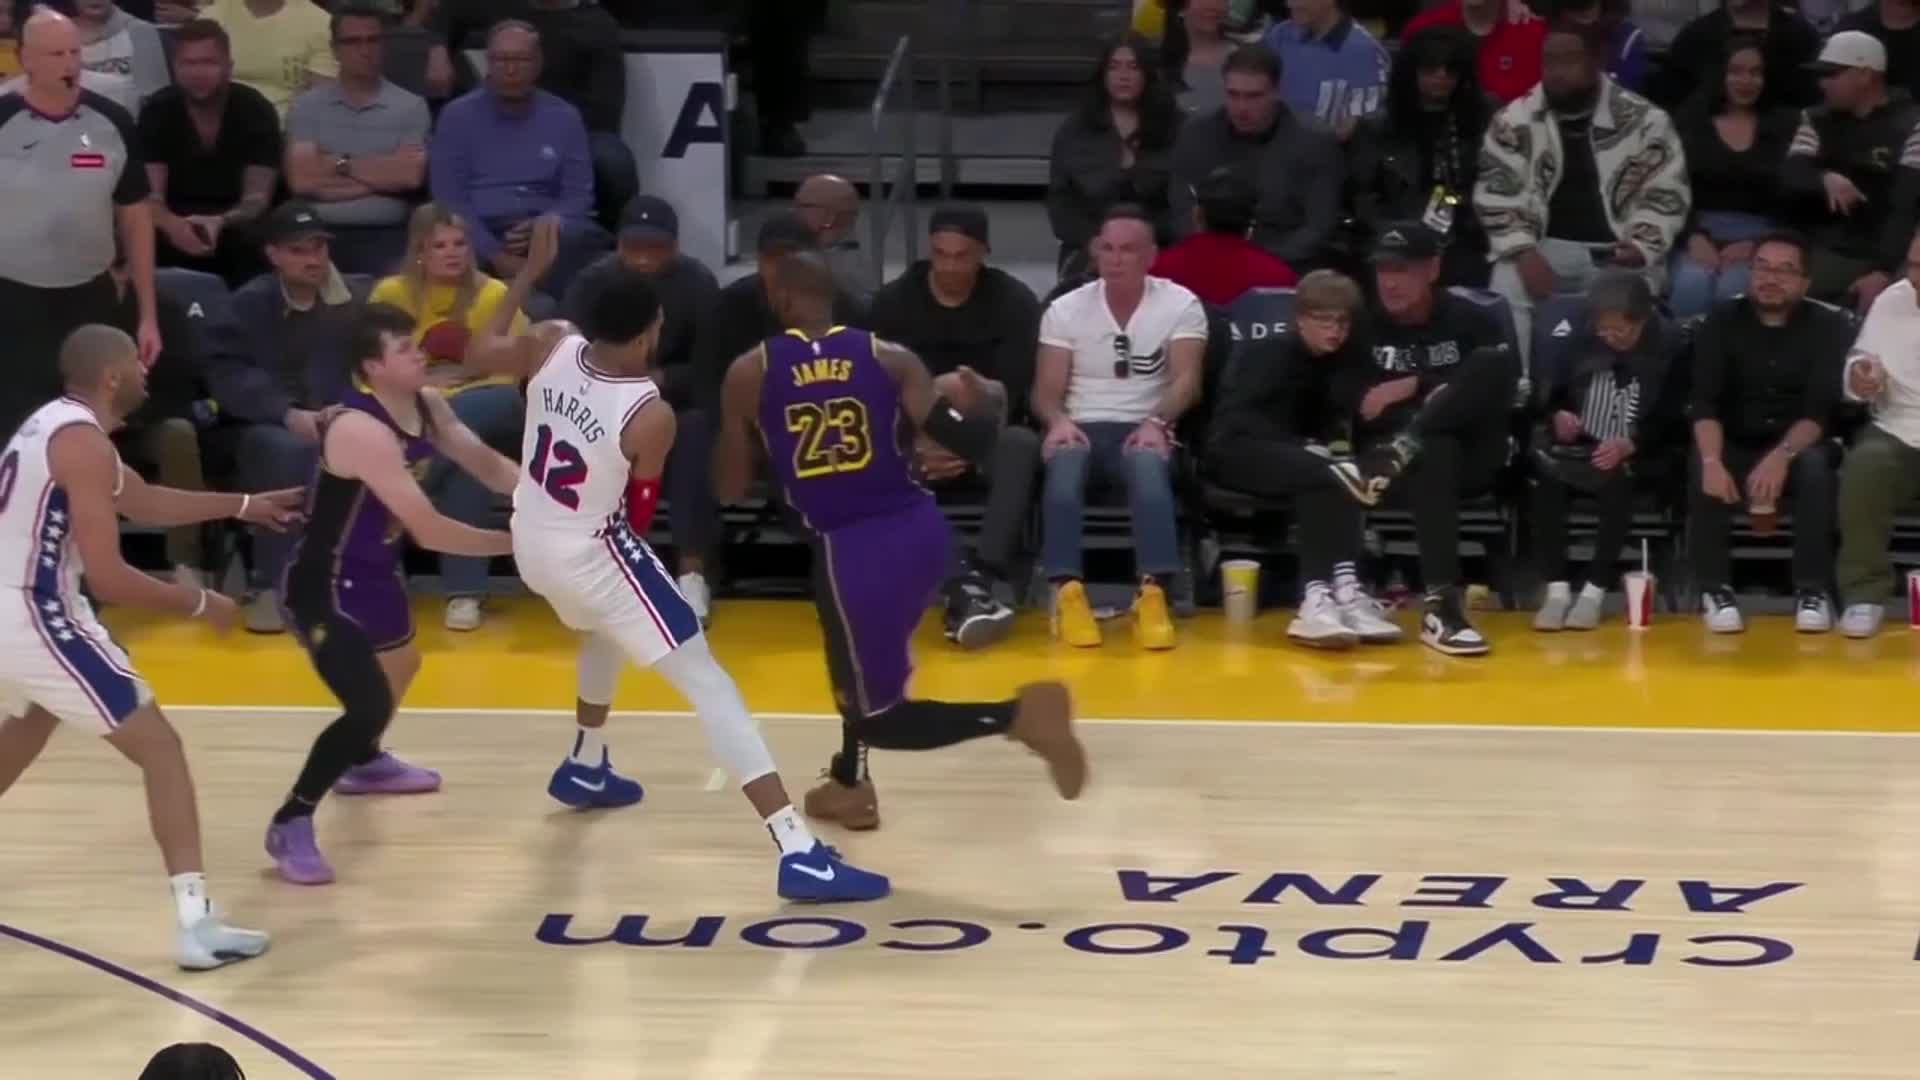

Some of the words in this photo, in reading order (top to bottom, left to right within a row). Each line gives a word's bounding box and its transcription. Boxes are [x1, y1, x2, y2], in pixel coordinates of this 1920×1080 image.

[660, 82, 727, 158] A
[791, 359, 852, 386] JAMES
[543, 388, 605, 443] HARRIS
[784, 397, 871, 478] 23
[529, 424, 588, 512] 12
[1117, 870, 1806, 913] ARENA
[534, 913, 1795, 967] crypto.com
